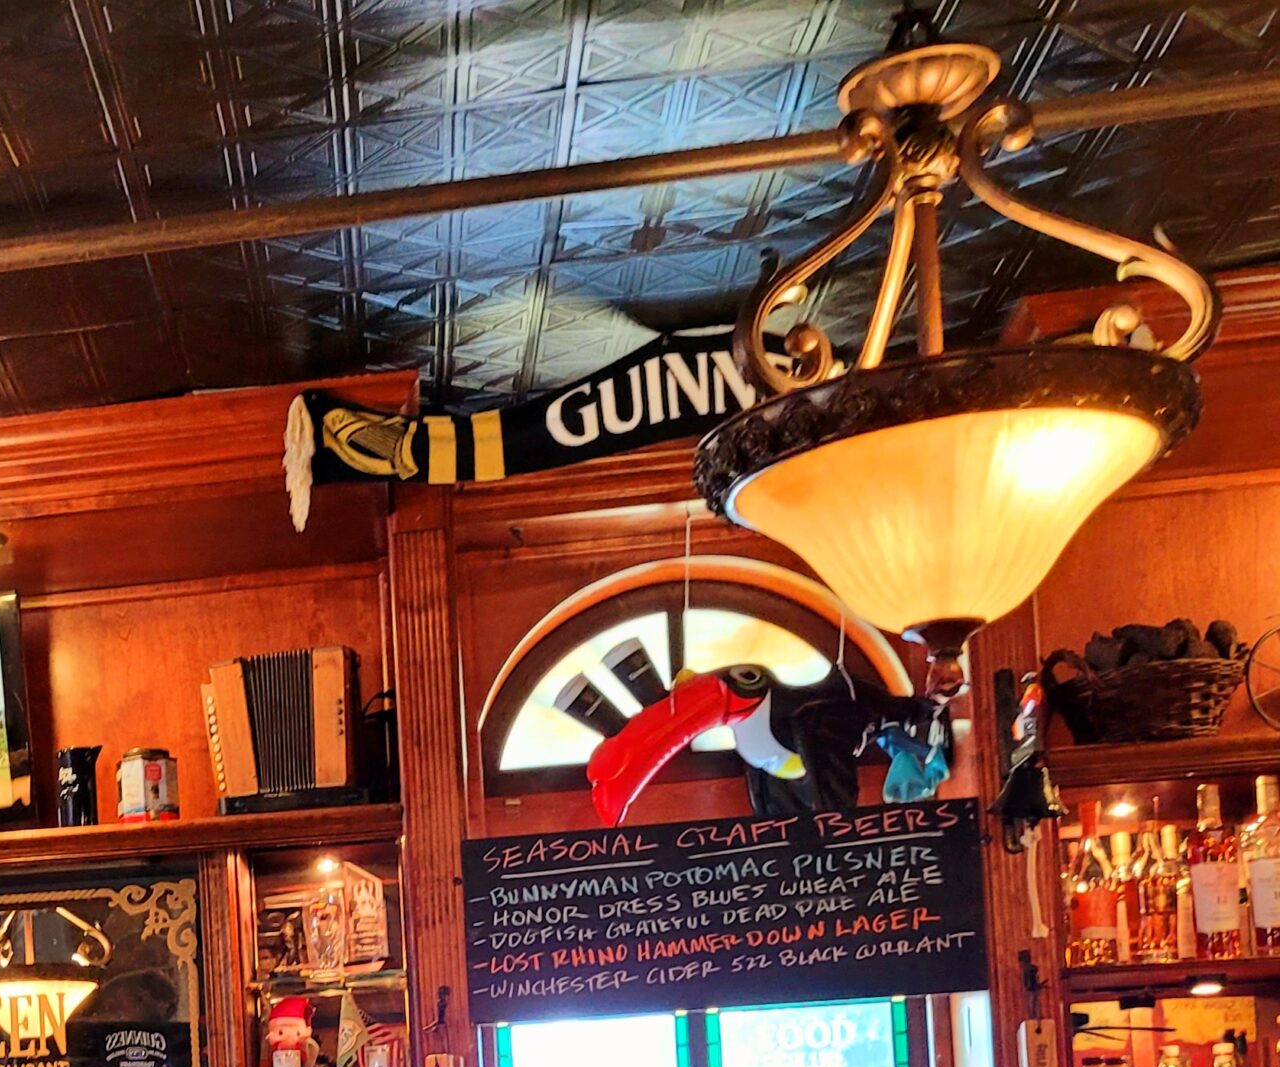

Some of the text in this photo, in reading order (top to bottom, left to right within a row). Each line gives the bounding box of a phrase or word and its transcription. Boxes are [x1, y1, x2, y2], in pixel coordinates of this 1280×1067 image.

[546, 350, 795, 447] GUINN
[483, 833, 659, 872] SEASONAL
[676, 816, 799, 847] CRAFT
[490, 846, 939, 907] BUNNYMAN POTOMAC PILSNER
[493, 864, 944, 927] HONOR DRESS BLUES WHEAT ALE
[490, 883, 921, 950] DOGFISH GRATEFUL DEAD PALE ALE
[491, 952, 544, 974] LOST
[552, 945, 628, 968] RHINO
[836, 907, 942, 937] LAGER
[490, 970, 639, 998] WINCHESTER
[646, 960, 721, 985] CIDER
[731, 954, 772, 973] 522
[779, 946, 848, 967] BLACK
